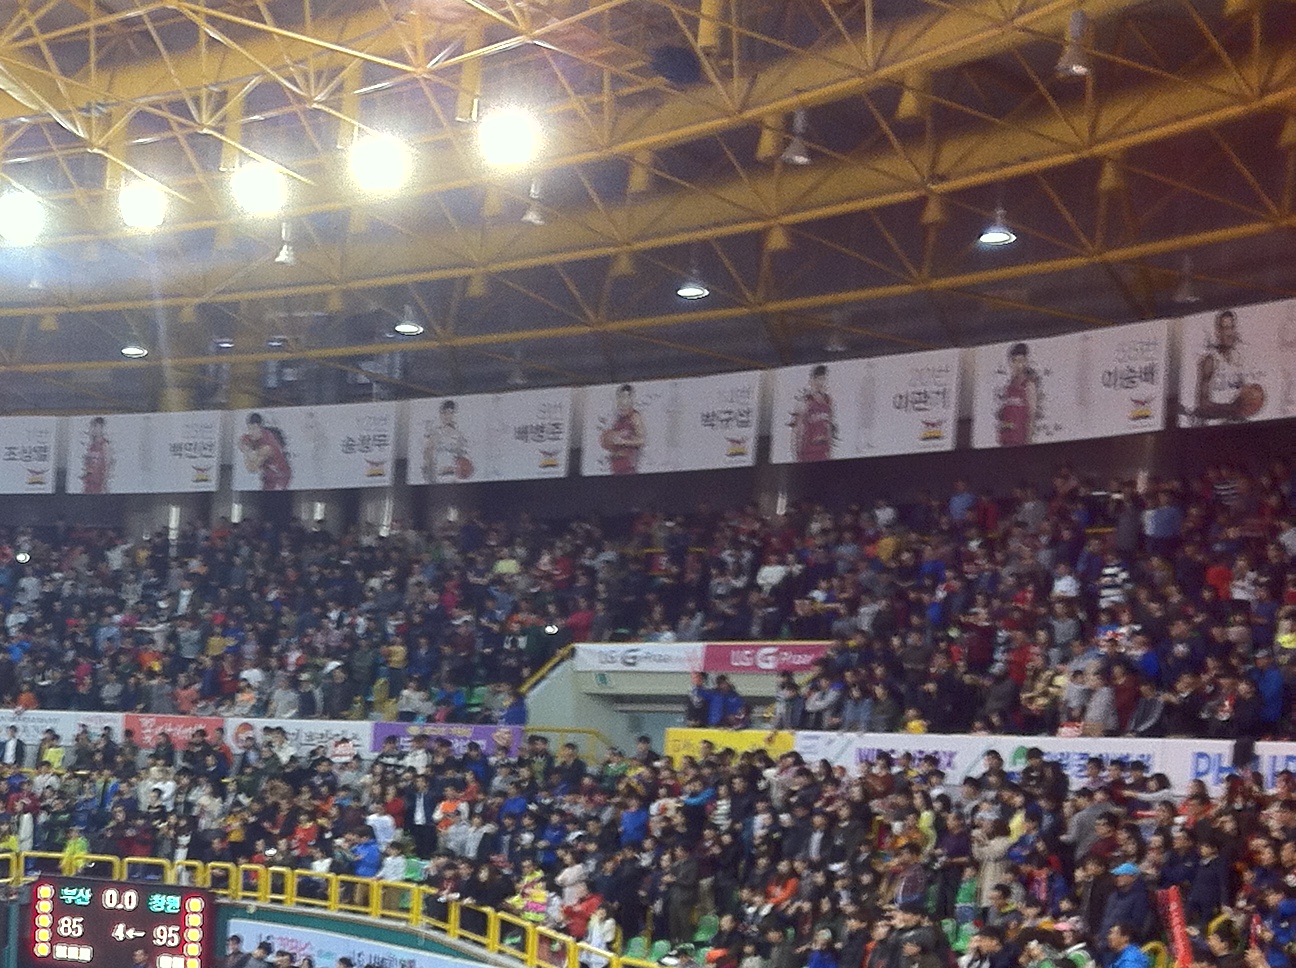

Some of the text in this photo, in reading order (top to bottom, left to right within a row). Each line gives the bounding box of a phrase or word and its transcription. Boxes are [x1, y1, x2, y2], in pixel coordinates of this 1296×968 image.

[59, 886, 182, 914] 부산 0.0 창원
[56, 915, 182, 948] 85 4 95
